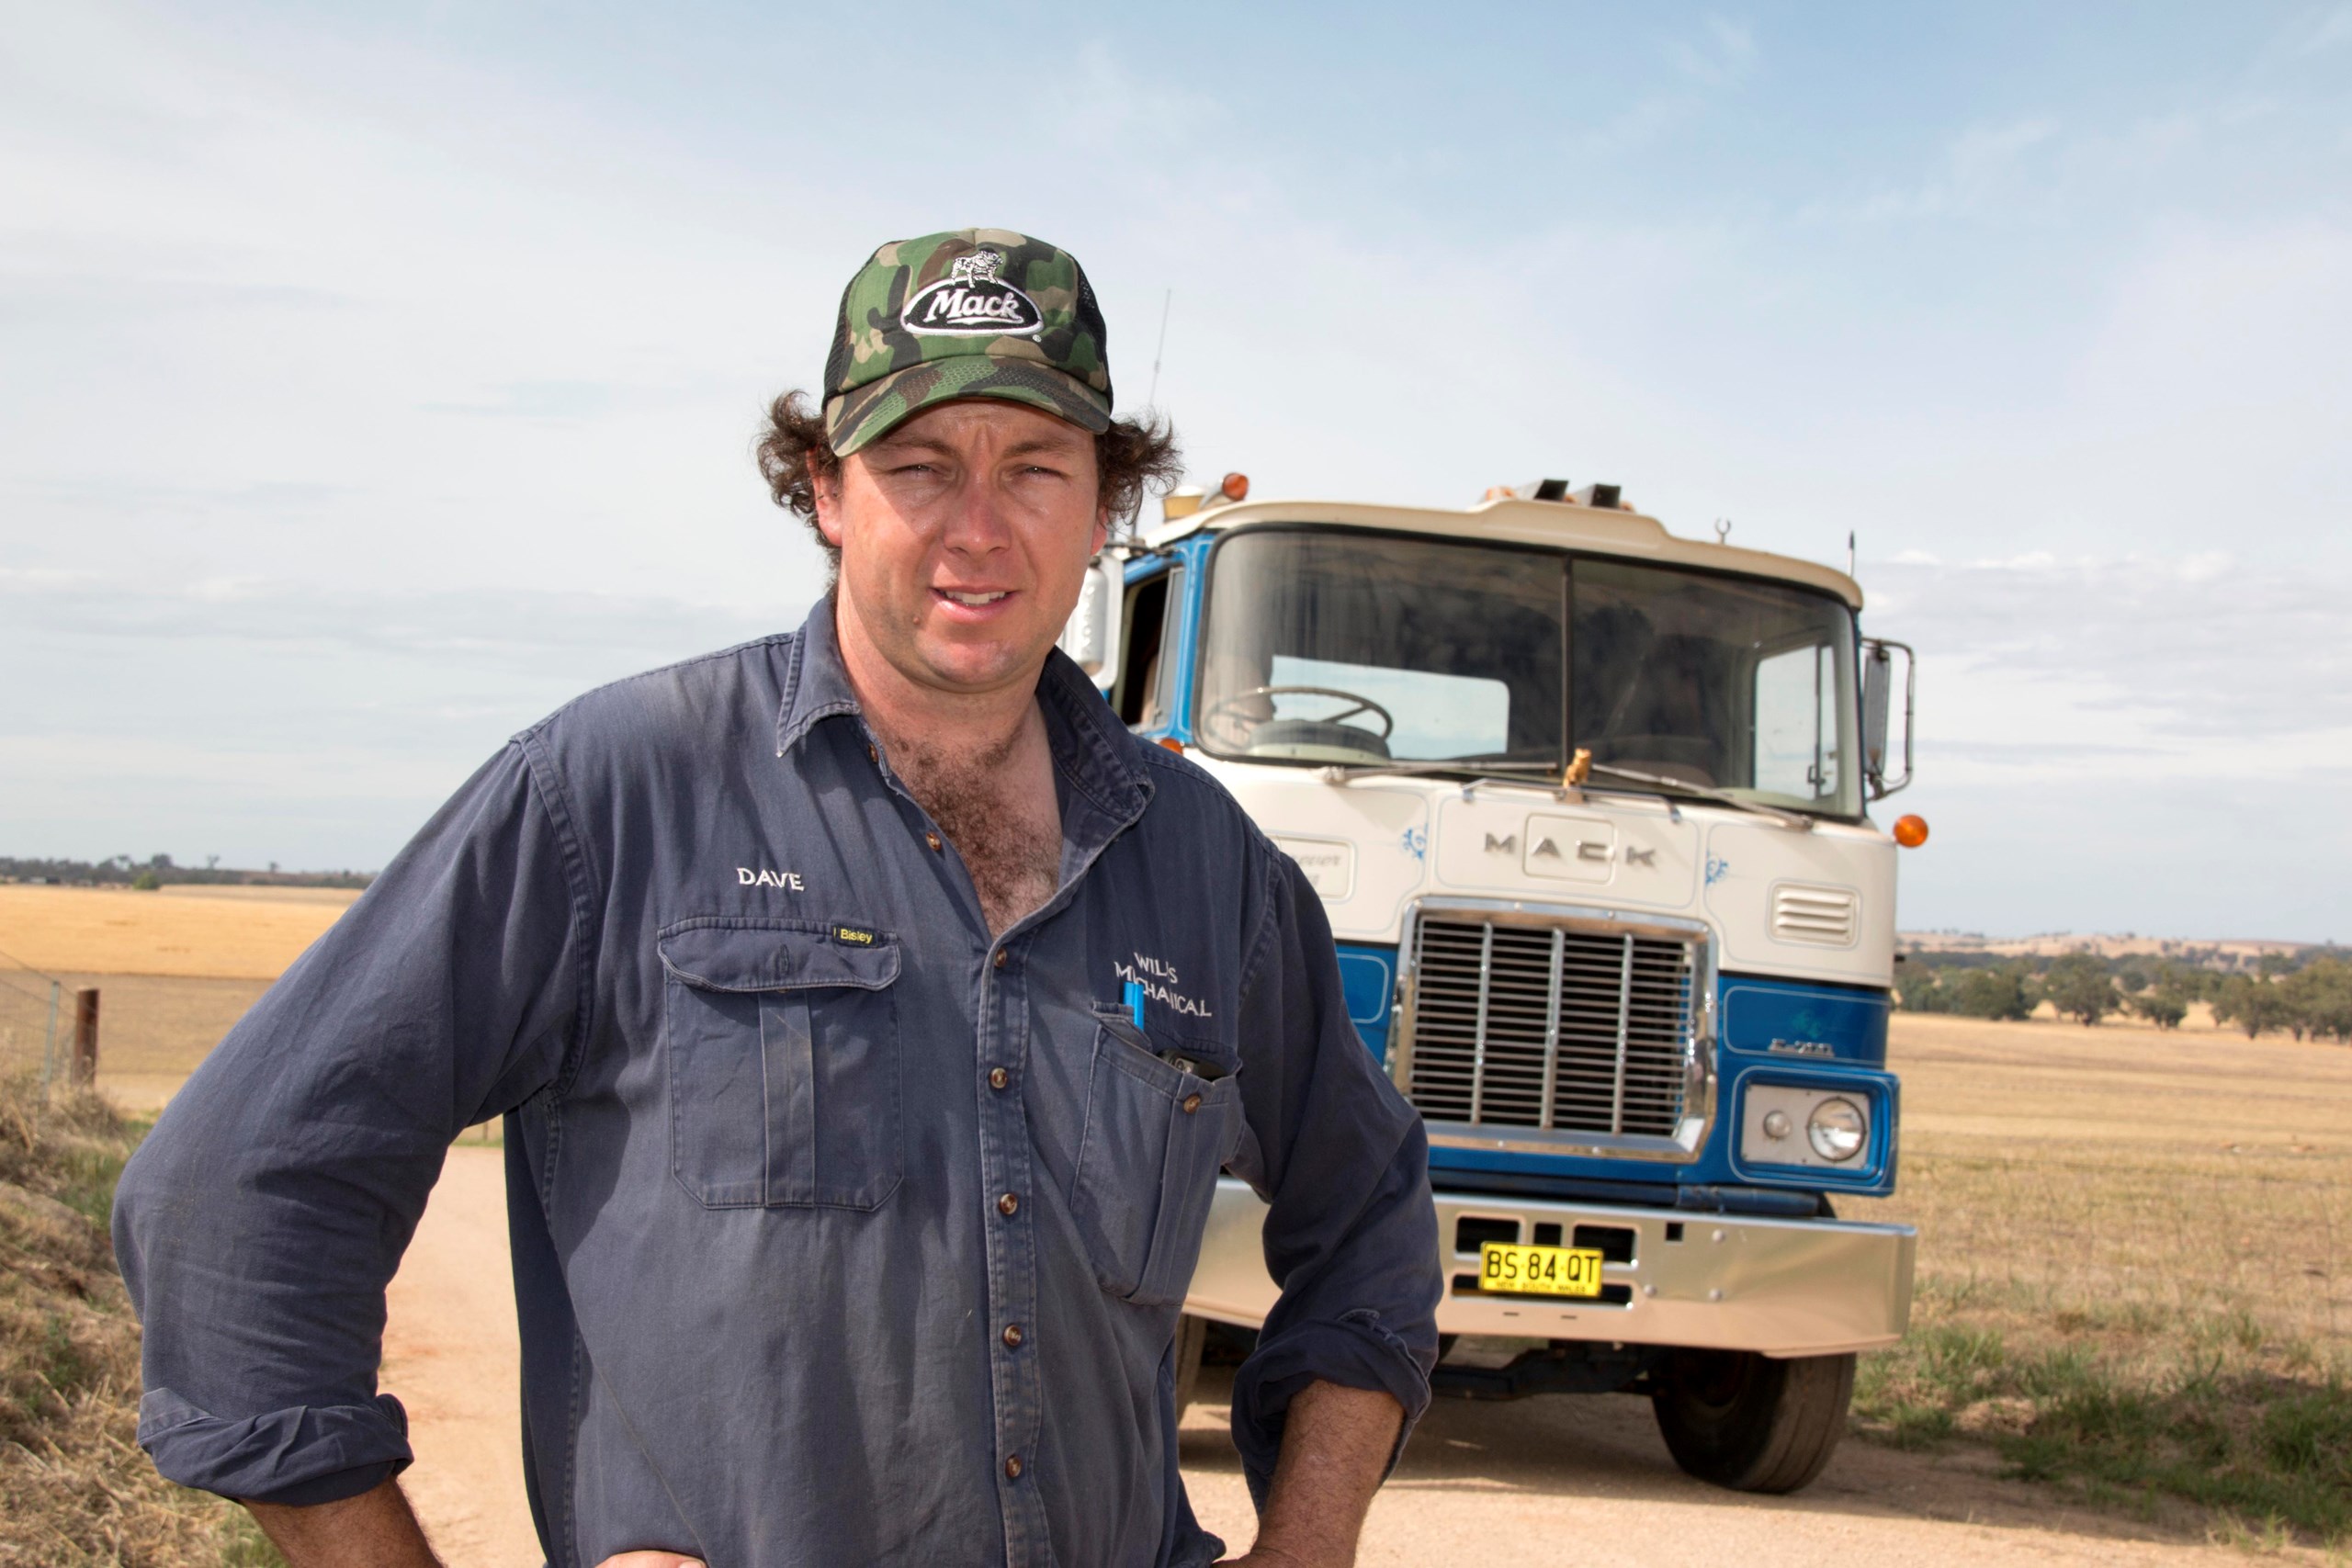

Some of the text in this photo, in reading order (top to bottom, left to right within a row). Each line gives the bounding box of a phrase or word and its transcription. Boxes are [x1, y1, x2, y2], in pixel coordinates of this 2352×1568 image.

[922, 288, 1024, 324] Mack
[1484, 832, 1656, 867] MACK
[736, 867, 805, 892] DAVE
[840, 929, 873, 944] Bisley
[1487, 1250, 1598, 1283] BS 84 QT
